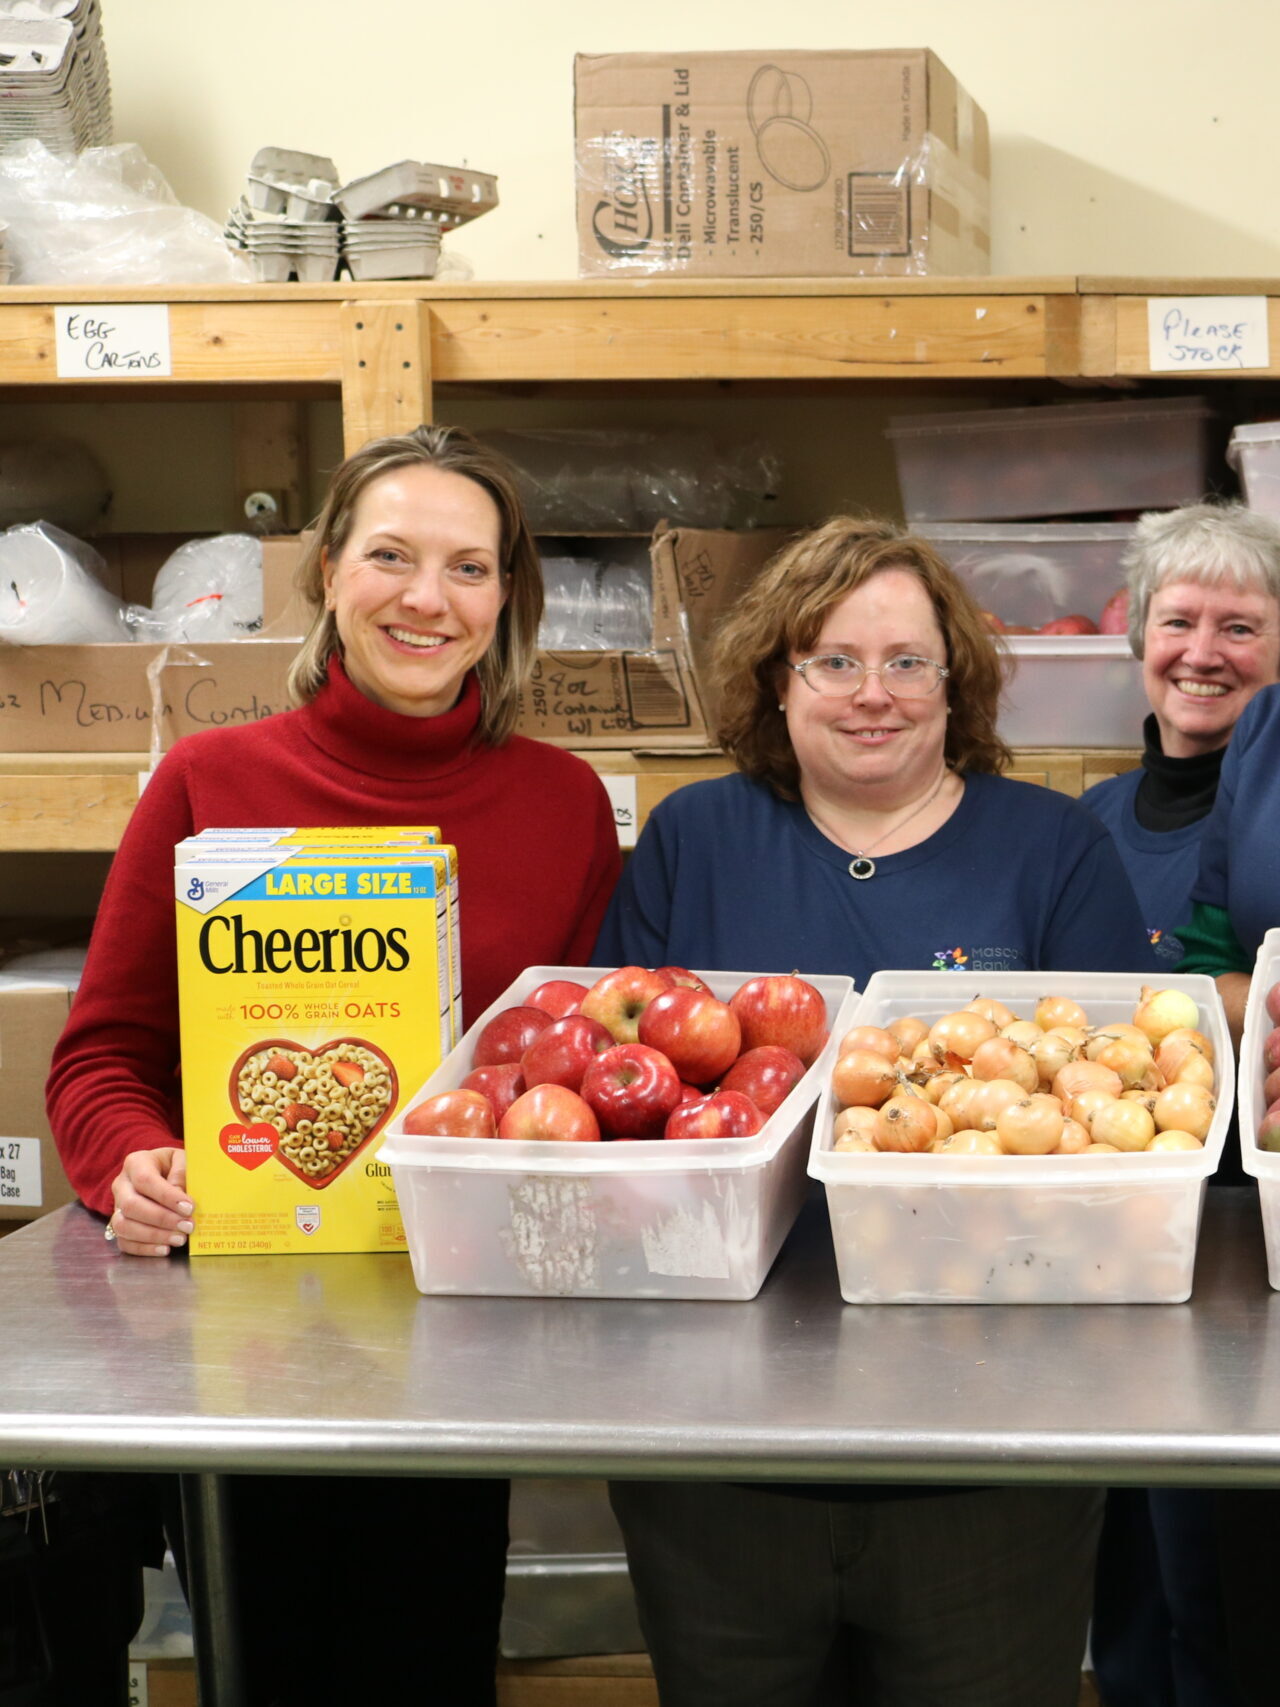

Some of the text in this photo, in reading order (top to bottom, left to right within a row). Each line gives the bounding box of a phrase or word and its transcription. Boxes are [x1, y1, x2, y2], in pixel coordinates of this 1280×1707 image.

[902, 66, 911, 102] Canada
[902, 115, 911, 141] Made
[674, 68, 692, 260] Deli Container & Lid
[704, 129, 716, 244] Microwavable
[727, 146, 740, 245] Translucent
[750, 181, 765, 244] 250/CS
[67, 314, 116, 340] EGG
[85, 341, 161, 371] CARTONS
[265, 873, 347, 896] LARGE
[357, 872, 412, 895] SIZE
[199, 914, 410, 974] Cheerios
[257, 982, 283, 990] Toasted
[284, 981, 304, 989] Whole
[306, 981, 324, 989] Grain
[338, 980, 360, 988] Cereal
[240, 1004, 299, 1020] 100%
[305, 1011, 339, 1019] GRAIN
[345, 1002, 400, 1018] OATS
[242, 1133, 271, 1144] lower
[9, 1144, 21, 1160] 27
[227, 1144, 273, 1153] CHOLESTEROL
[1, 1166, 15, 1181] Bag
[365, 1163, 392, 1177] Glut
[1, 1184, 20, 1198] Case
[249, 1241, 272, 1249] (340g)
